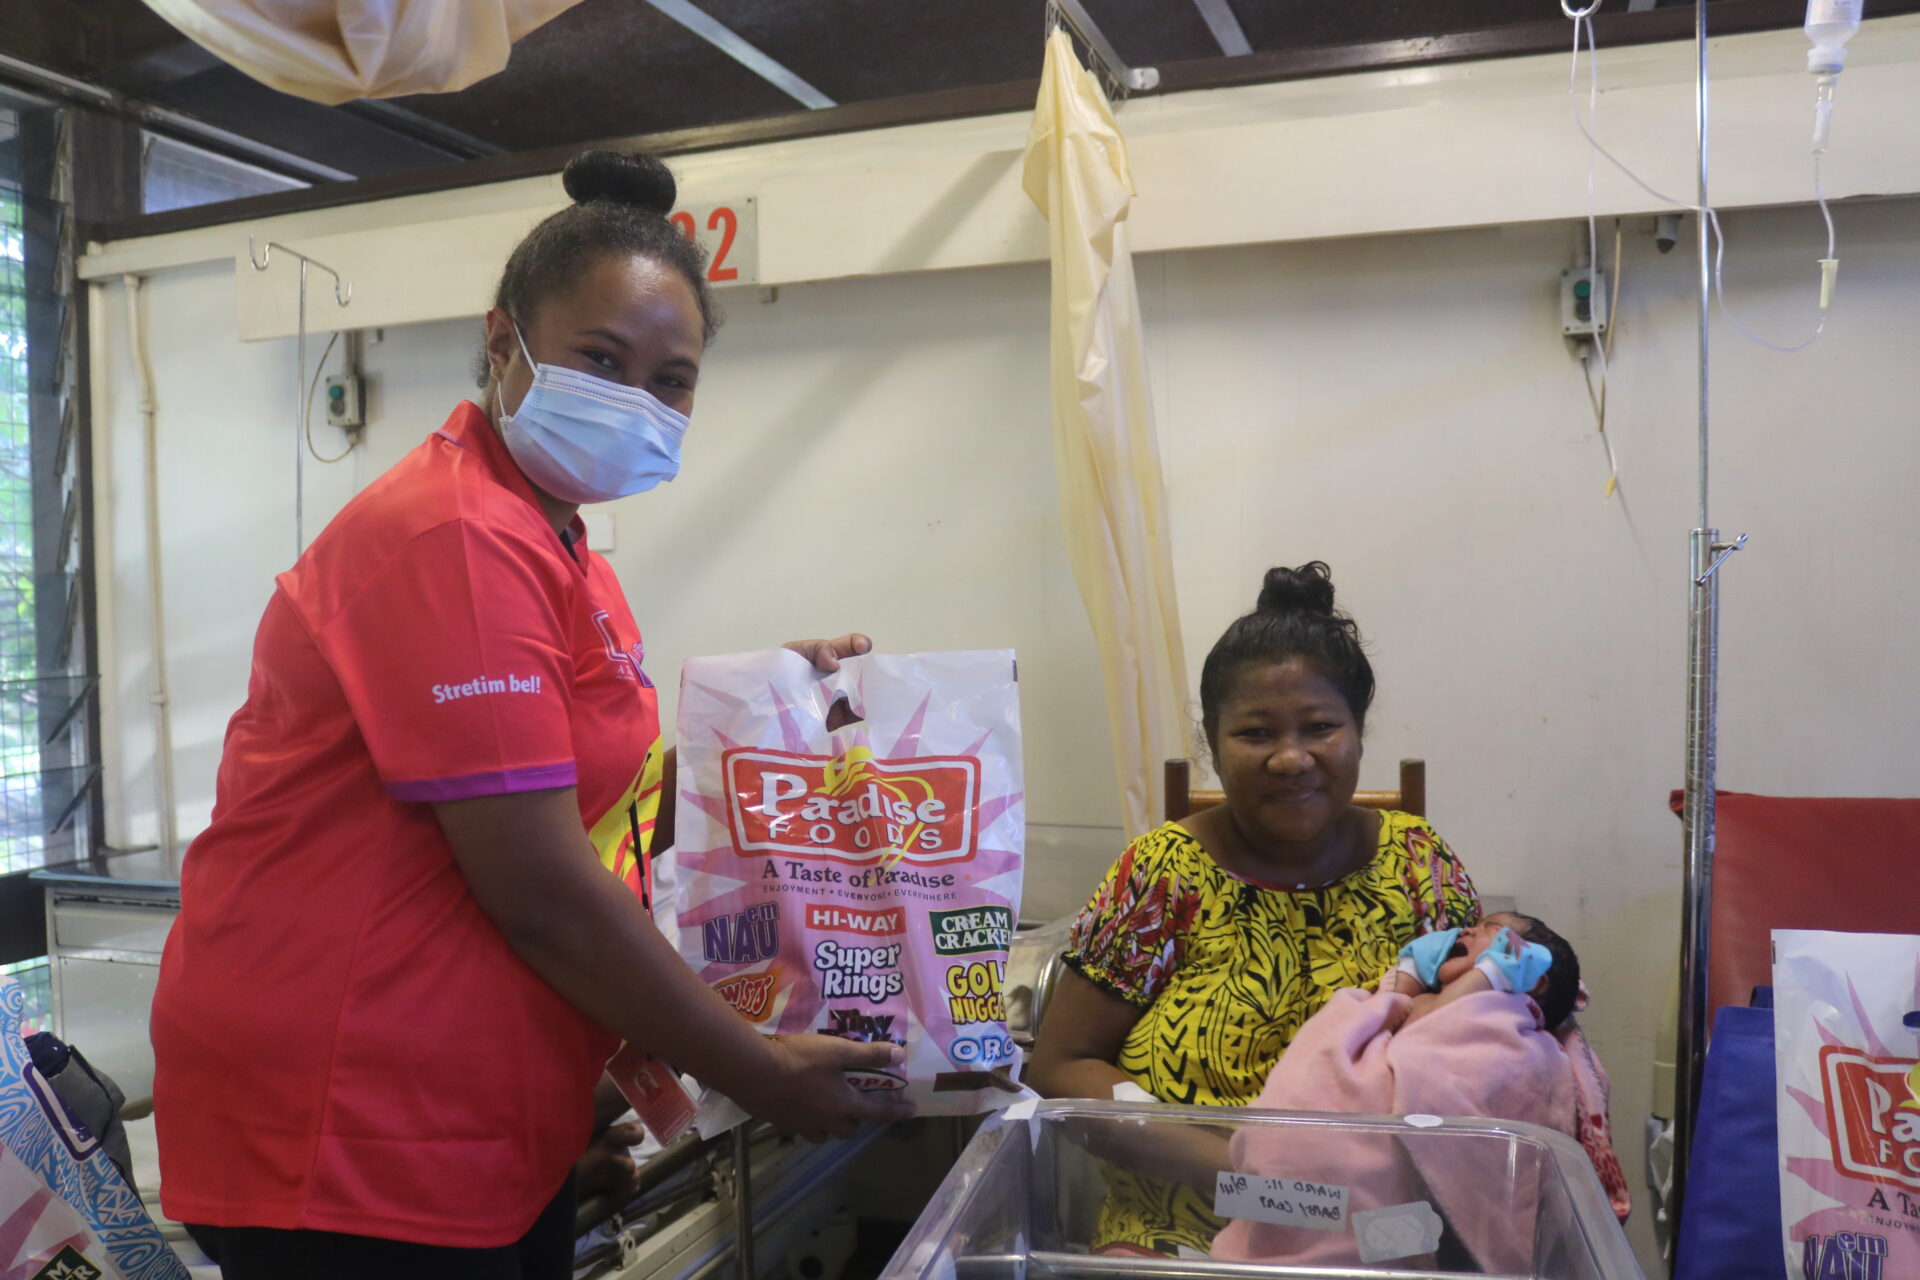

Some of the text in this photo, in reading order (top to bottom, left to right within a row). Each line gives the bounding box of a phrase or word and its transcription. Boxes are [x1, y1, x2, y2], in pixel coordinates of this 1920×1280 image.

[432, 673, 541, 704] Stretim bel!
[760, 771, 946, 825] Paradise
[768, 819, 943, 850] FOODS
[761, 859, 955, 889] A Taste of Paradise
[763, 884, 826, 896] ENJOYMENT
[894, 888, 957, 901] EVERYWHERE
[813, 910, 899, 932] HI-WAY
[941, 911, 1008, 933] CREAM
[702, 913, 780, 964] NAU
[935, 928, 1012, 950] CRACKE
[814, 940, 901, 974] Super
[822, 968, 904, 1004] Rings
[946, 959, 1008, 998] GOL
[1867, 1187, 1891, 1211] A
